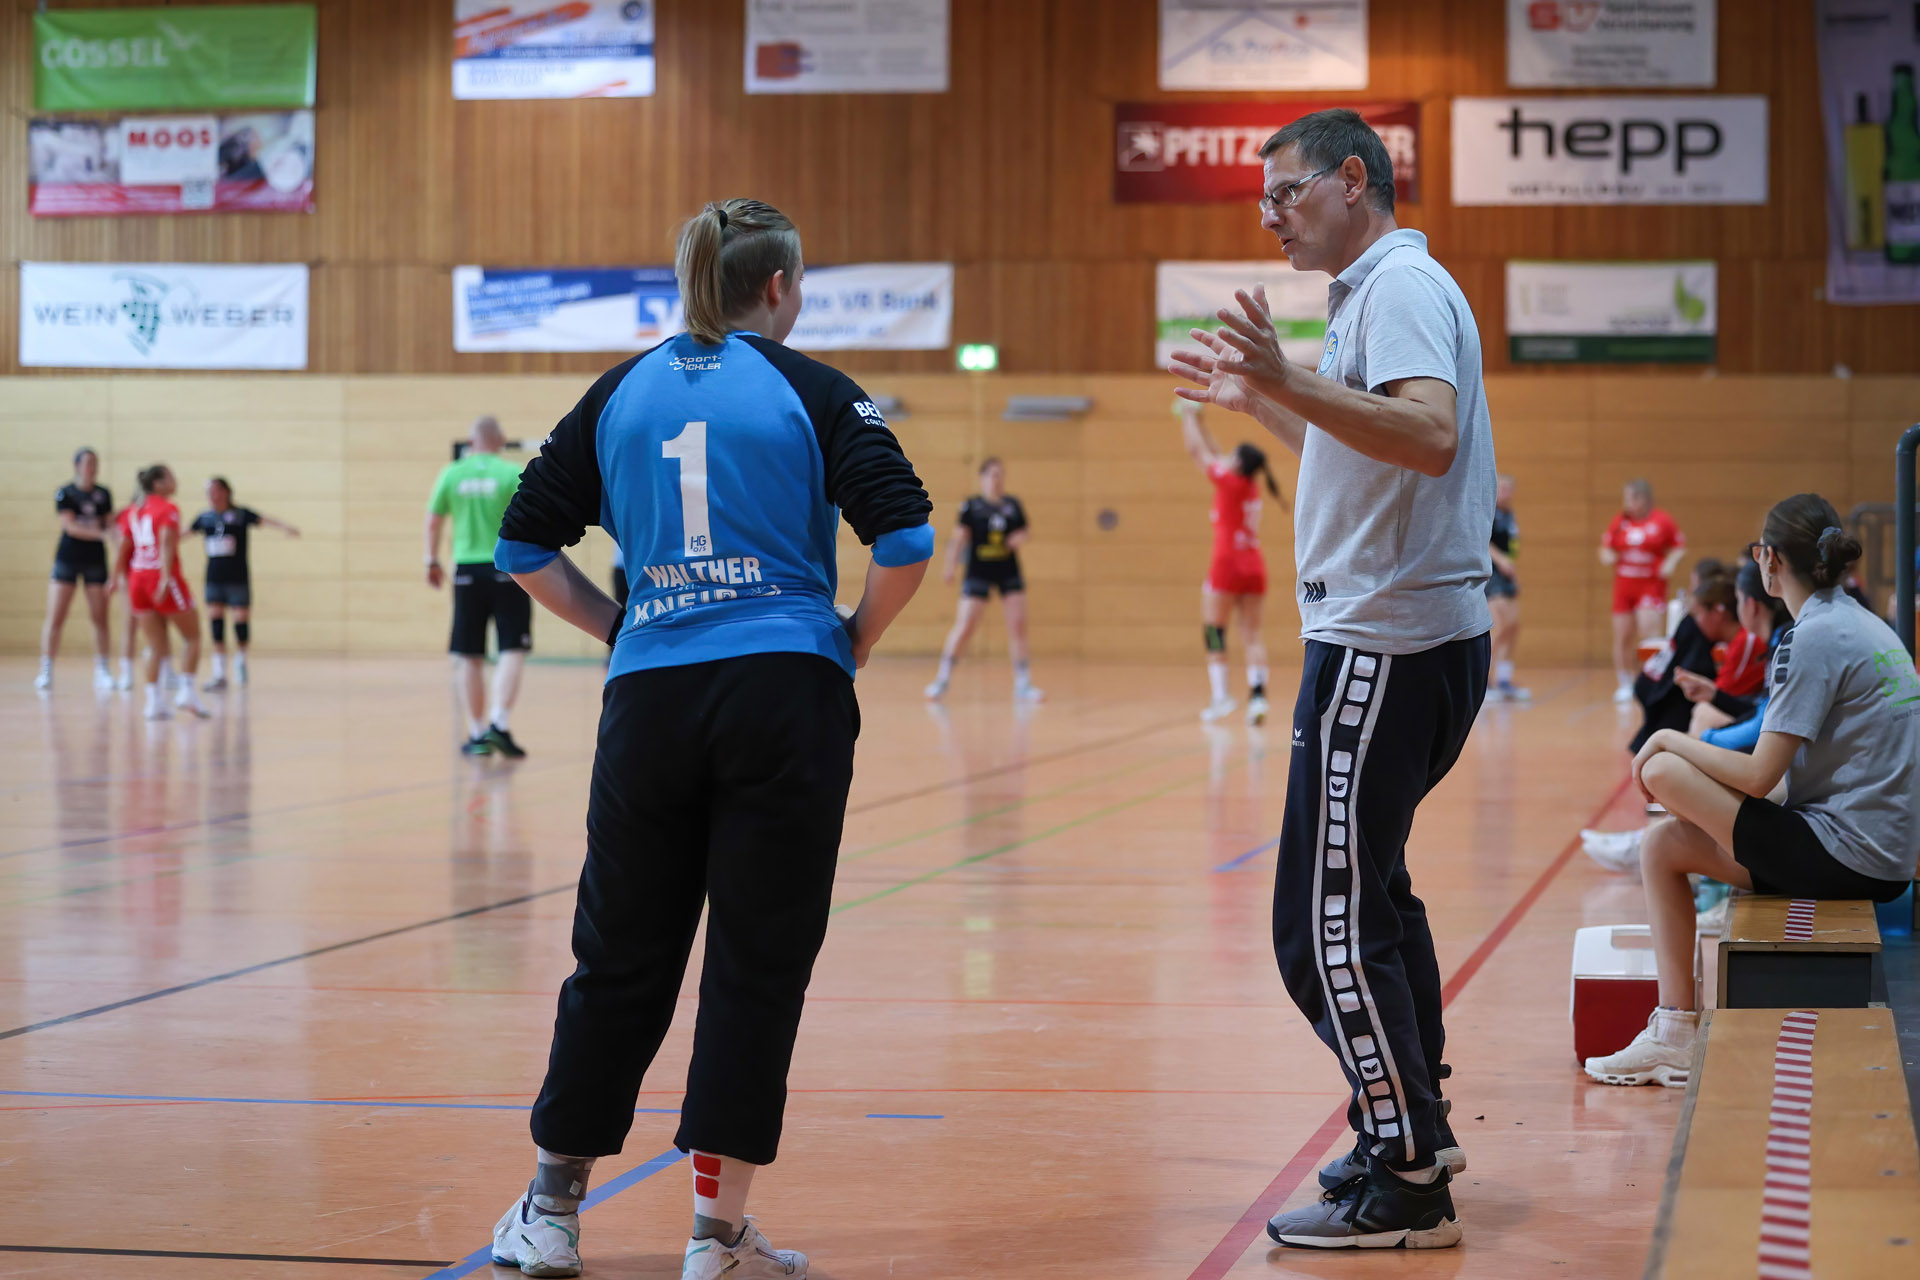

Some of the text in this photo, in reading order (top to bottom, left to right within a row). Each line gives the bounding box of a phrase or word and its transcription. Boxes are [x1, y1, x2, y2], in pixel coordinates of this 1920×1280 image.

[127, 128, 211, 148] MOOS
[1497, 107, 1724, 174] hepp
[33, 302, 295, 328] WEIN WEBER
[662, 421, 713, 557] 1
[690, 535, 706, 550] HG
[643, 556, 763, 589] WALTHER
